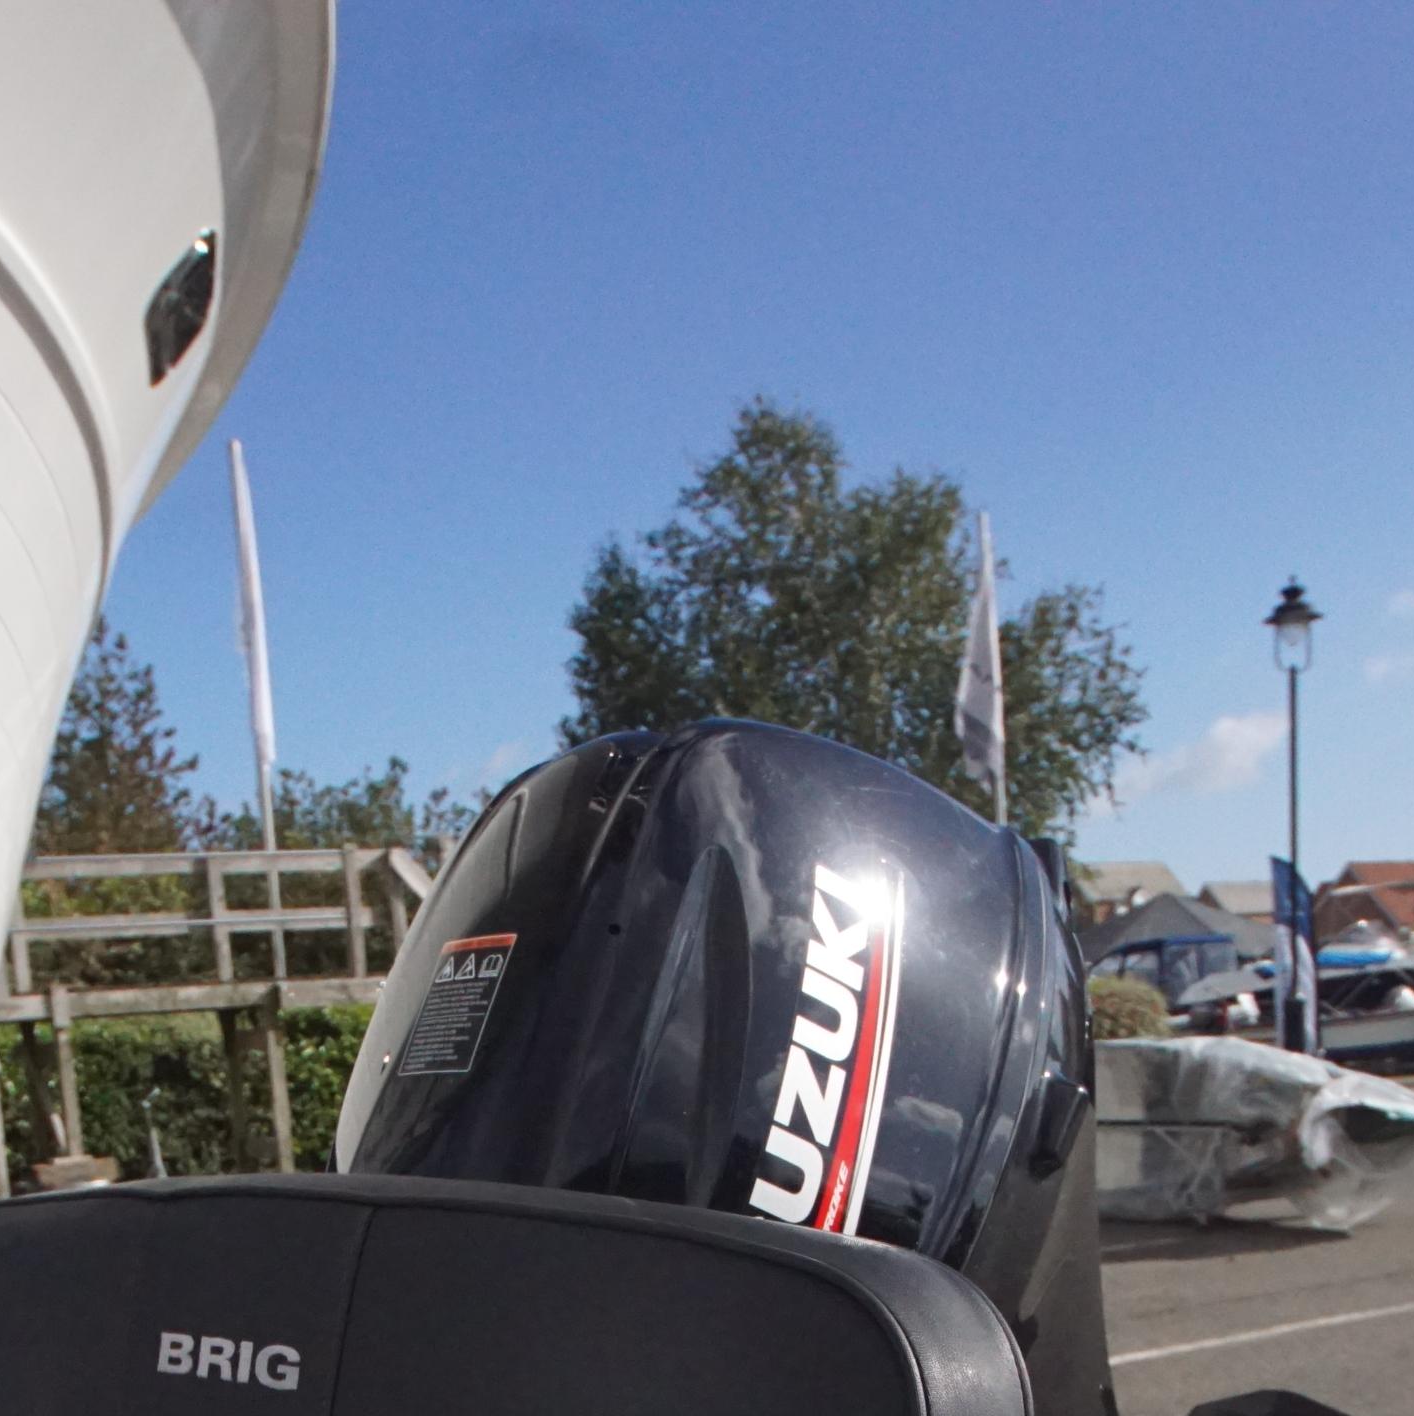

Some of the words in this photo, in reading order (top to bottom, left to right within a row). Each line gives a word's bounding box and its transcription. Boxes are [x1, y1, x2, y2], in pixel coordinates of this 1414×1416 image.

[748, 864, 879, 1224] UZUKI
[823, 1159, 849, 1231] ROKE
[157, 1331, 301, 1390] BRIG
